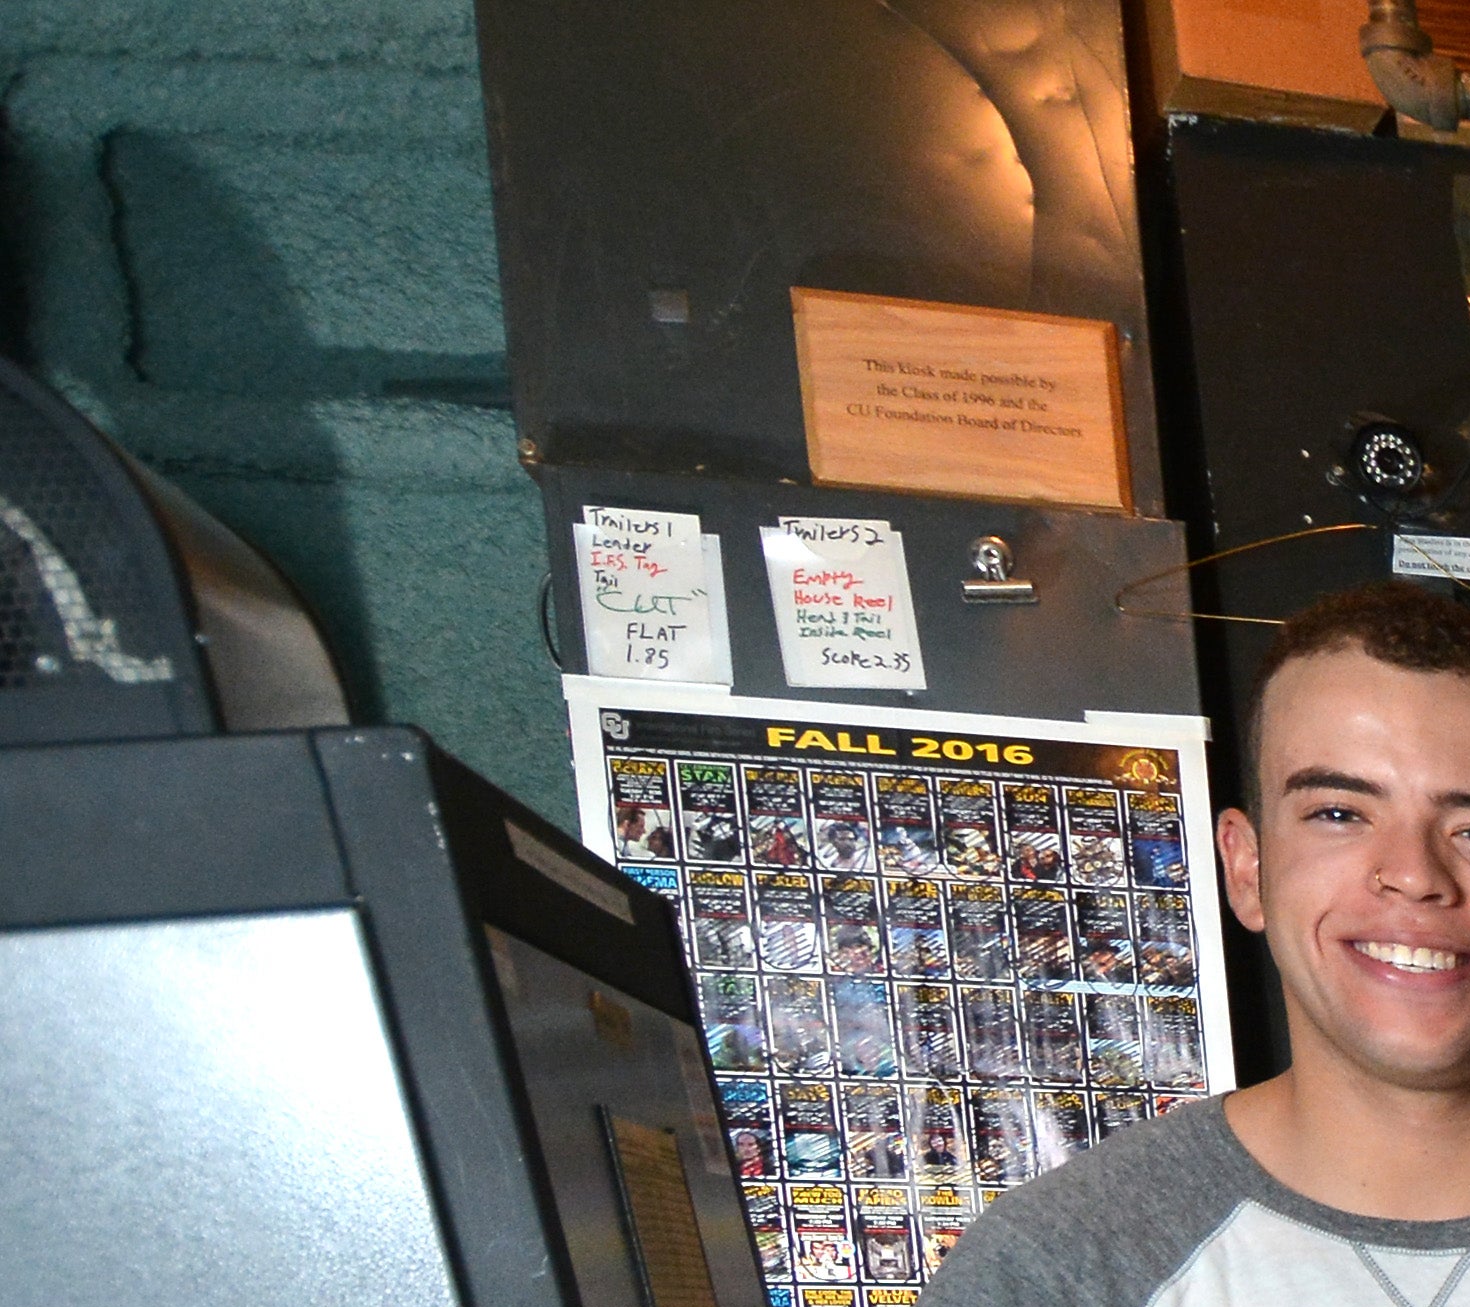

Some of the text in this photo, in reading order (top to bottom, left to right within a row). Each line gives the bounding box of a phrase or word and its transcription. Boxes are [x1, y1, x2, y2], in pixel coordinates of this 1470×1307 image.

[864, 358, 1057, 392] This kiosk made possible by
[877, 383, 1047, 412] the Class of 1996 and the
[846, 403, 1083, 437] CU Foundation Board of Directors
[589, 507, 660, 537] Trailers
[783, 520, 885, 545] Trailers 2
[592, 534, 653, 552] Leader
[636, 556, 668, 577] Tag
[1399, 560, 1410, 569] Do
[1412, 561, 1426, 570] not
[1452, 564, 1464, 573] the
[793, 569, 863, 592] Empty
[794, 590, 893, 611] House Reel
[626, 622, 687, 641] FLAT
[626, 644, 670, 667] 1.85
[875, 651, 911, 673] 2.35
[766, 726, 897, 756] FALL
[911, 737, 1034, 765] 2016
[793, 1197, 843, 1205] MUCH
[869, 1295, 918, 1305] VELVET
